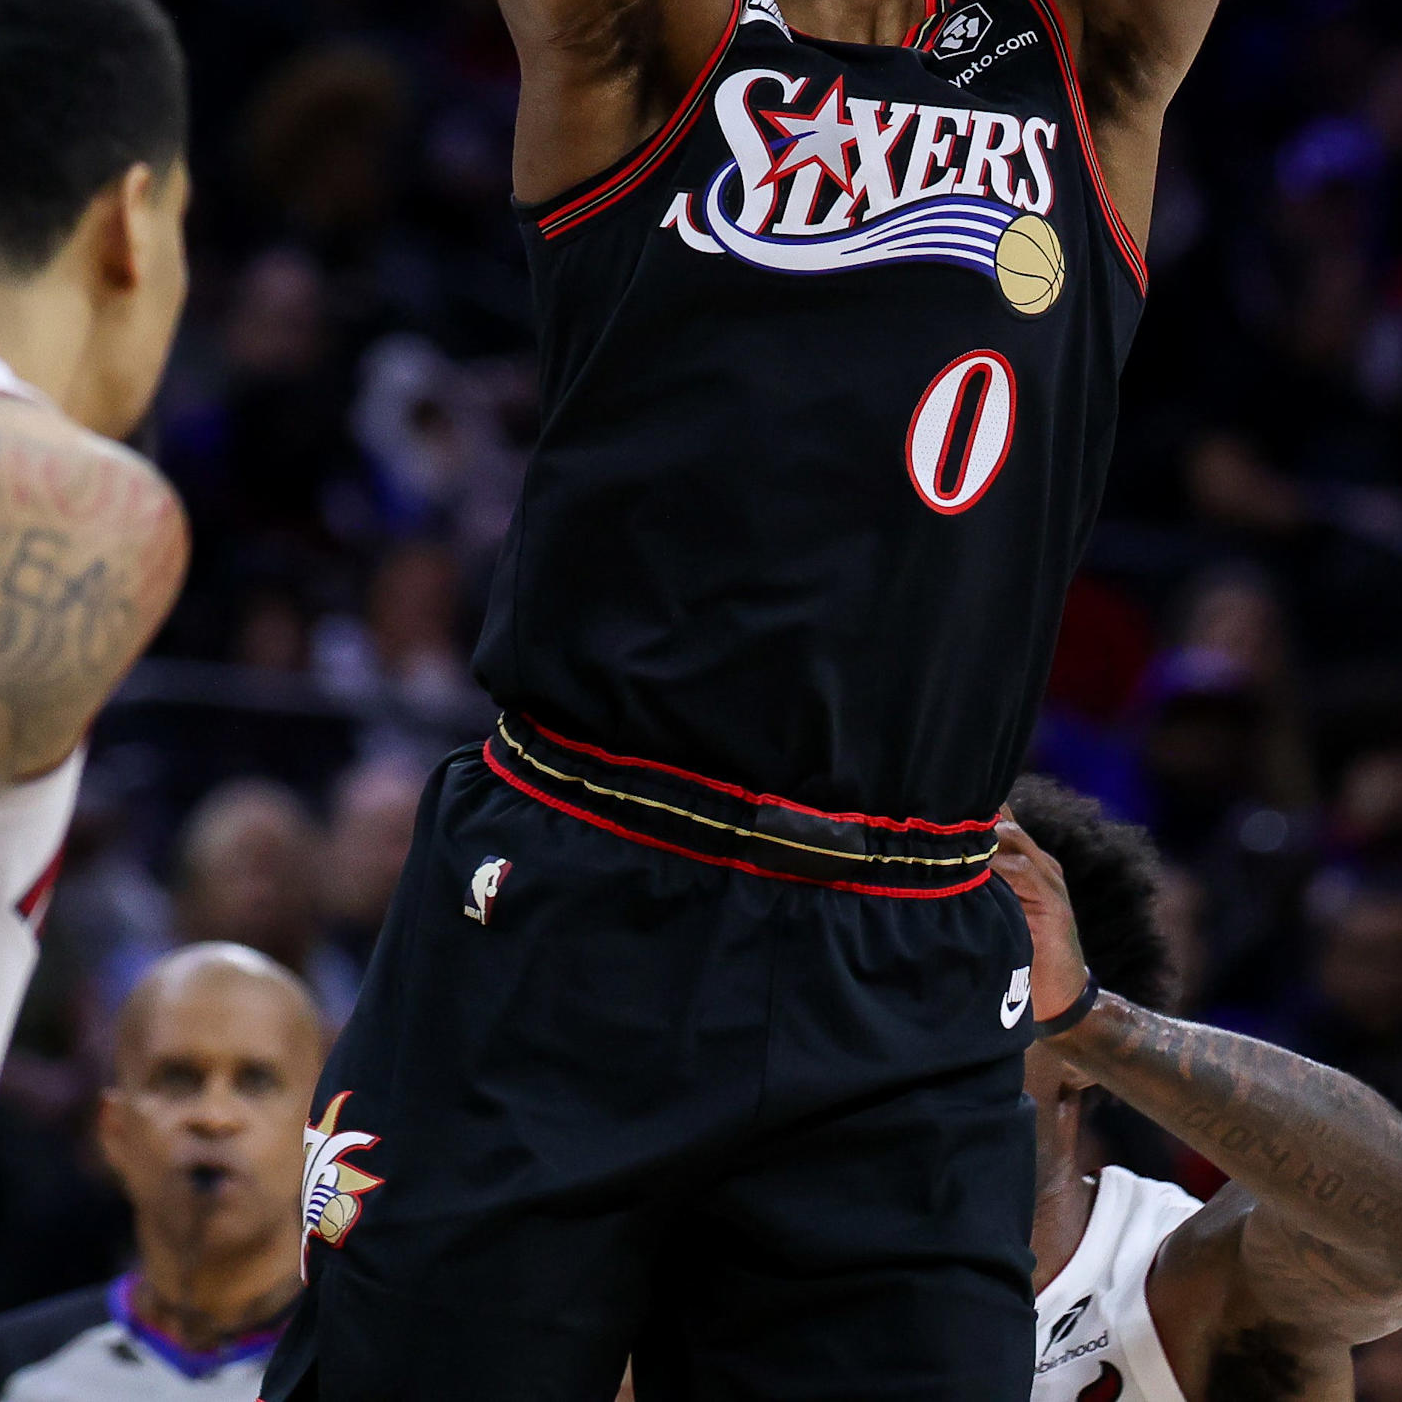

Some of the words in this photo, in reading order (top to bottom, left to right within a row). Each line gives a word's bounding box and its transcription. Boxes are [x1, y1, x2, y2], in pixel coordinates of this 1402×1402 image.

[948, 30, 1038, 89] ypto.com
[660, 67, 1060, 255] SIXERS
[905, 349, 1017, 515] 0
